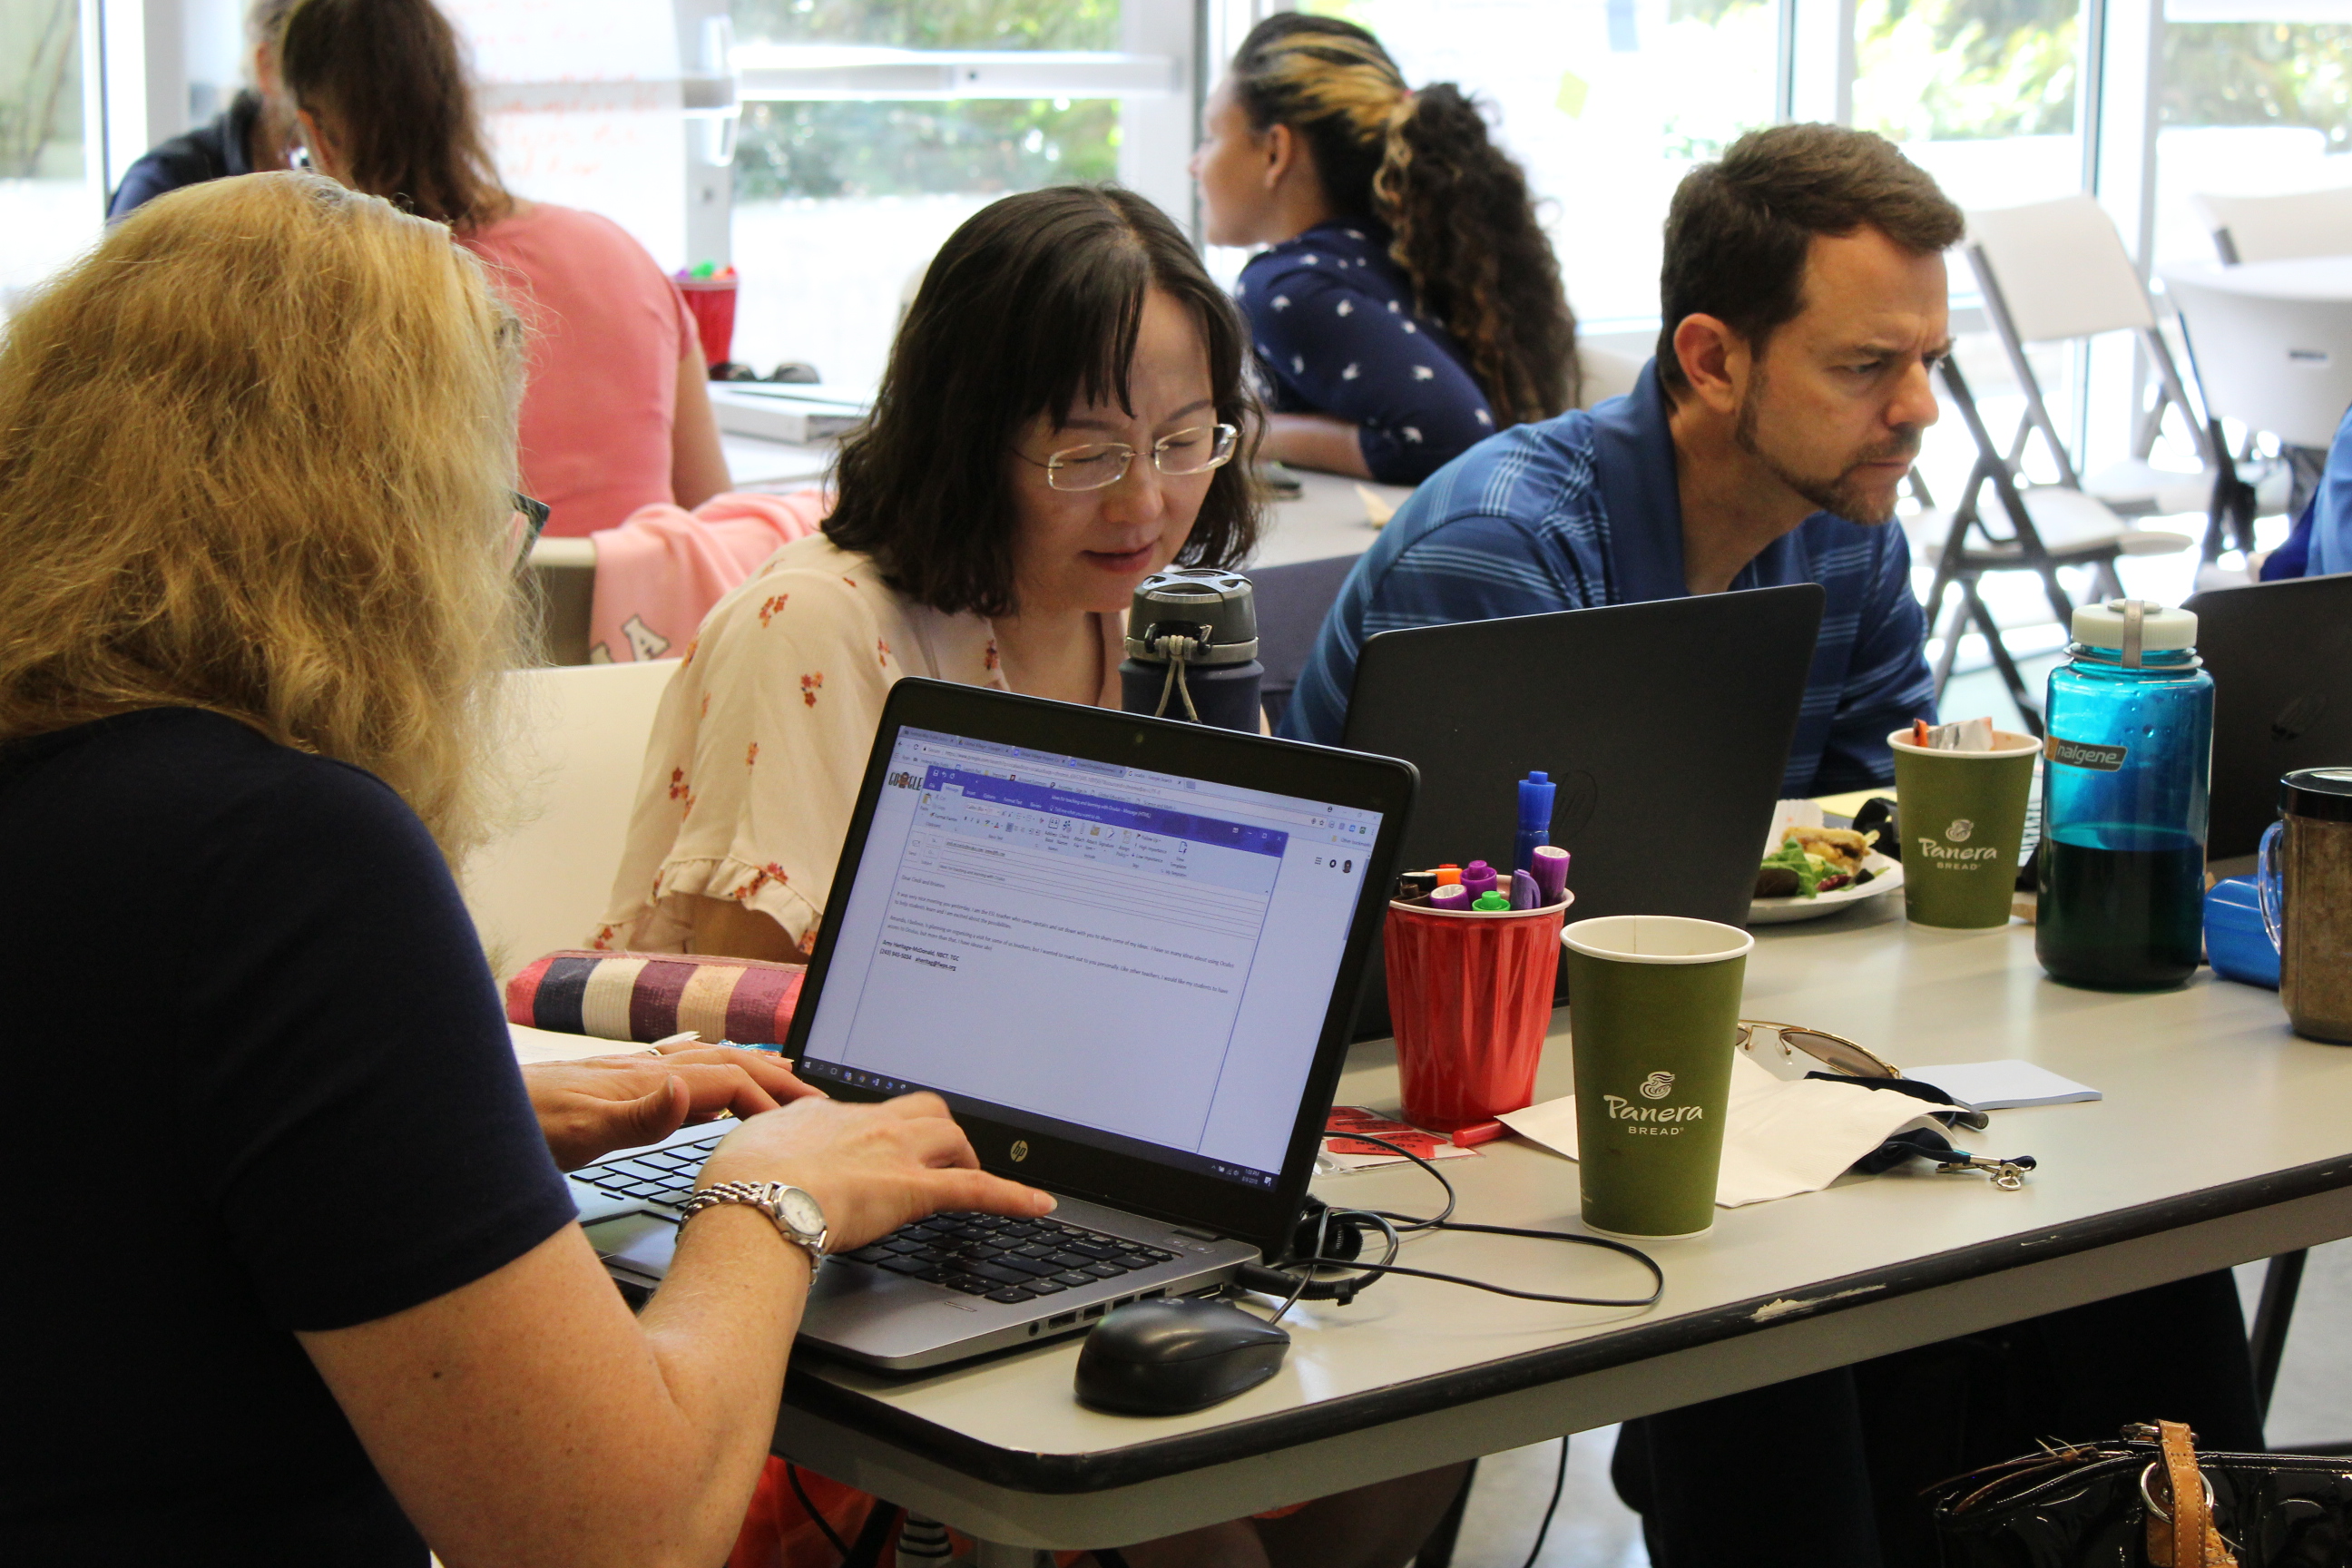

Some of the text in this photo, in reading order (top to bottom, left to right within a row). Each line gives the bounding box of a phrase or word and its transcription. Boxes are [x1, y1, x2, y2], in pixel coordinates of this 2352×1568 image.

[2057, 745, 2122, 765] nalgene
[1918, 838, 1997, 860] Panera
[1936, 862, 1978, 870] BREAD
[1603, 1094, 1702, 1122] Panera
[1628, 1126, 1680, 1135] BREAD
[1011, 1140, 1027, 1161] hp
